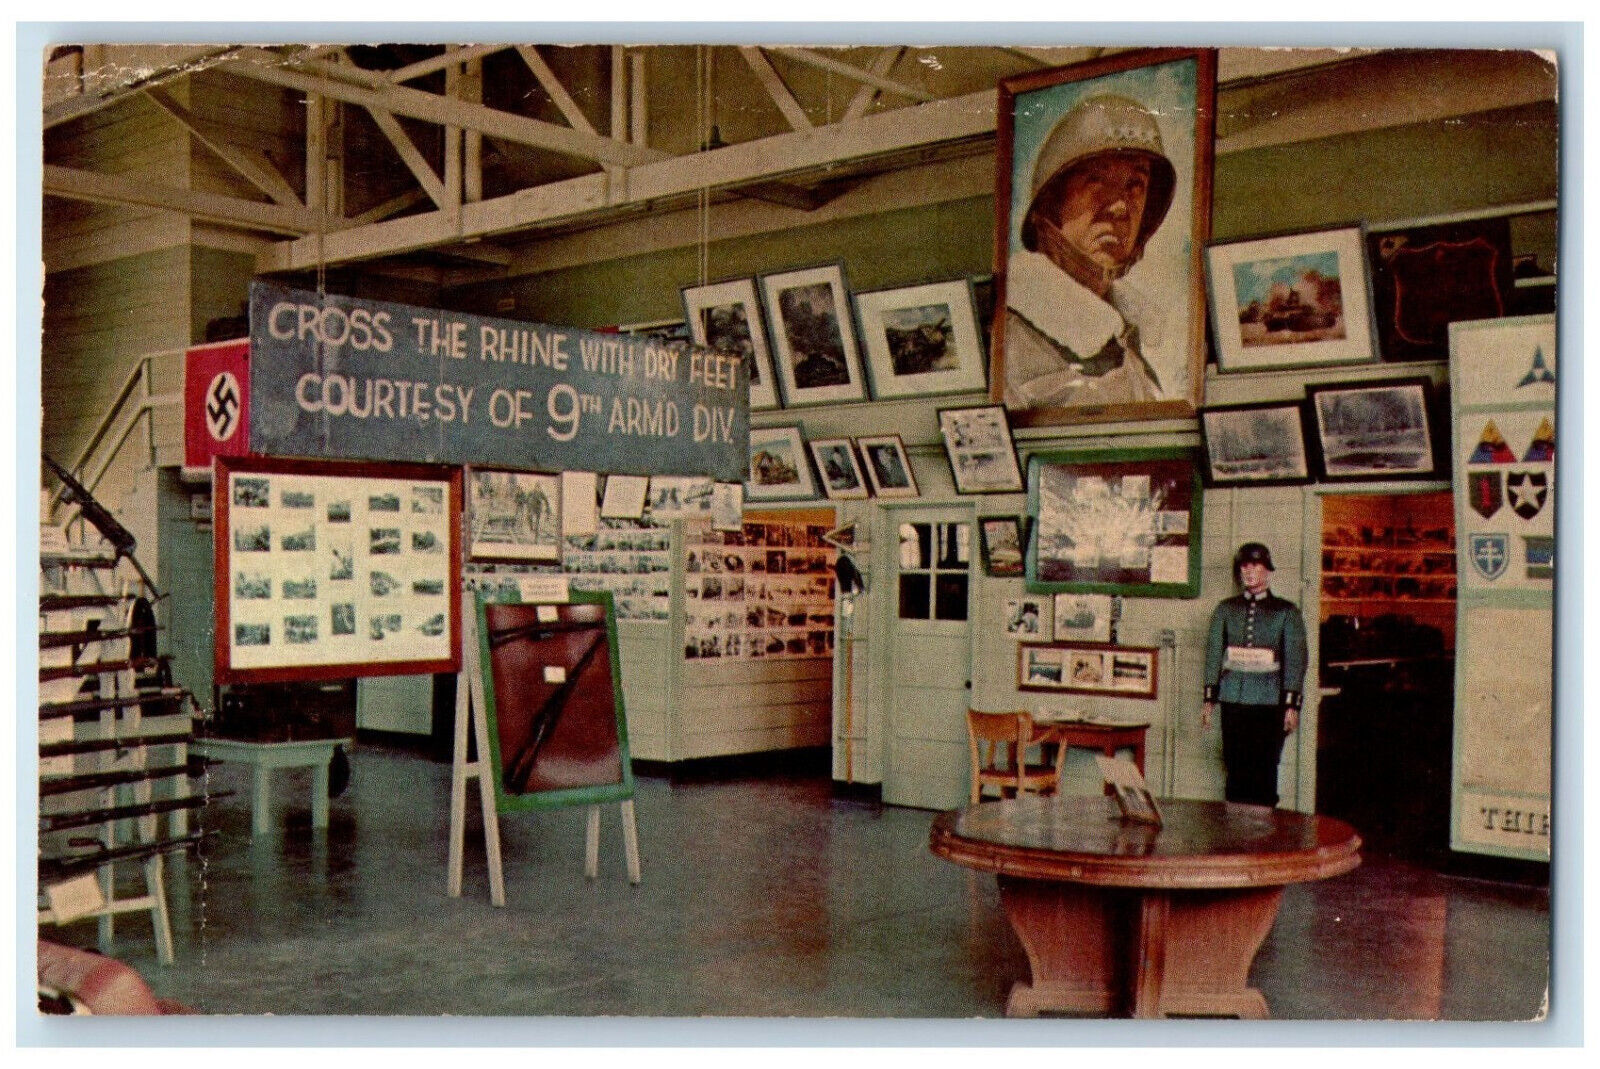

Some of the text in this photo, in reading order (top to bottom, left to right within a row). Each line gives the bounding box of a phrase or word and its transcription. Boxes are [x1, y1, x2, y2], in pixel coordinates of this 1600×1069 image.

[268, 302, 741, 390] CROSS THE RHINE WITH DRY FEET
[295, 372, 474, 424] COURTESY
[489, 388, 533, 429] OF
[547, 383, 603, 442] 9TH
